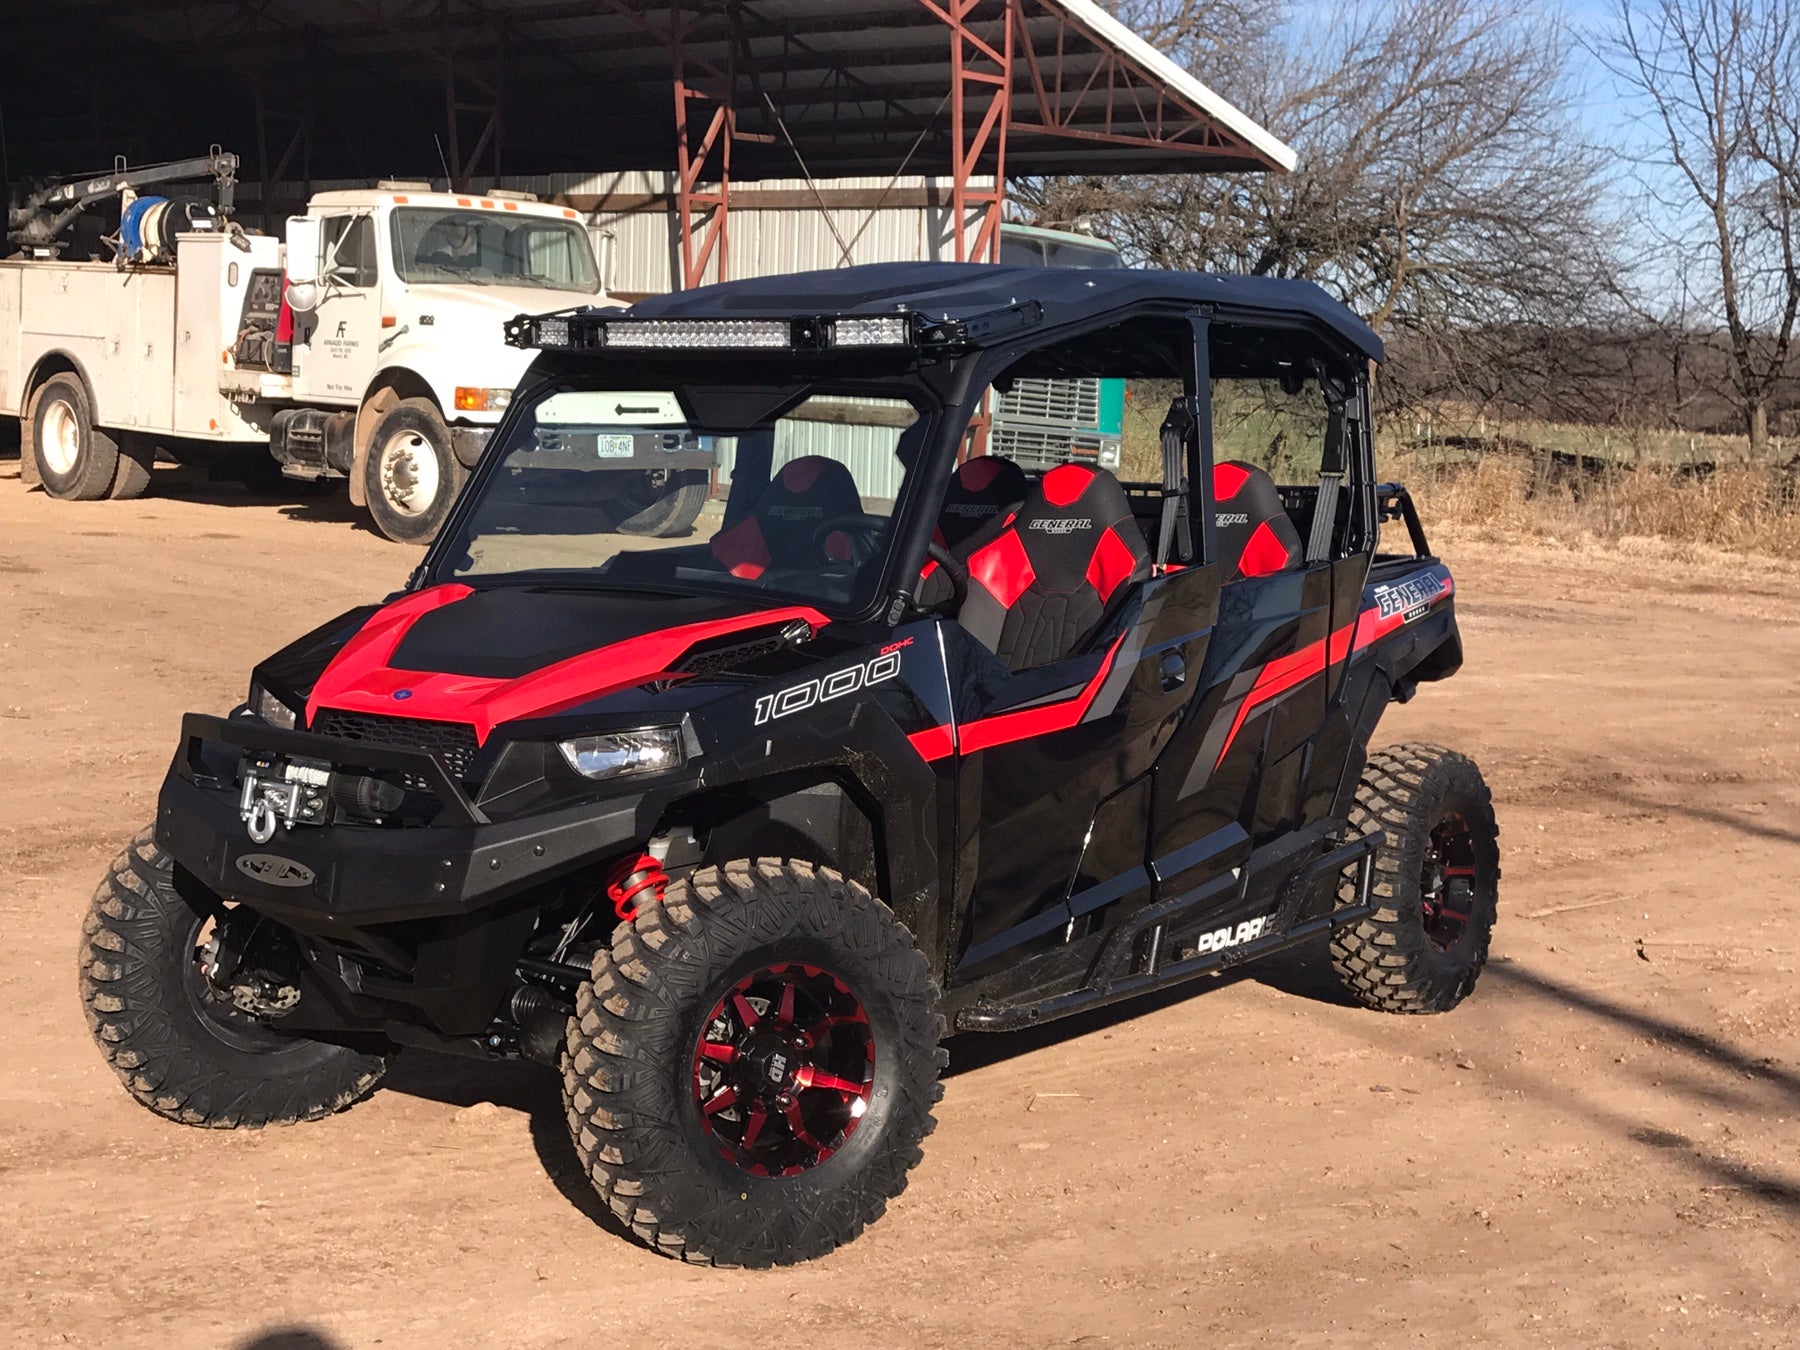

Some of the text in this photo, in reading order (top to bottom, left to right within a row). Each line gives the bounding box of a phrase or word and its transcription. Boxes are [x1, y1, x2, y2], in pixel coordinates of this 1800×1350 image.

[1029, 519, 1092, 529] GENERAL
[1374, 572, 1447, 620] GENERAL
[880, 637, 914, 655] DOHC
[754, 650, 901, 726] 1000
[1198, 913, 1276, 951] POLARIS
